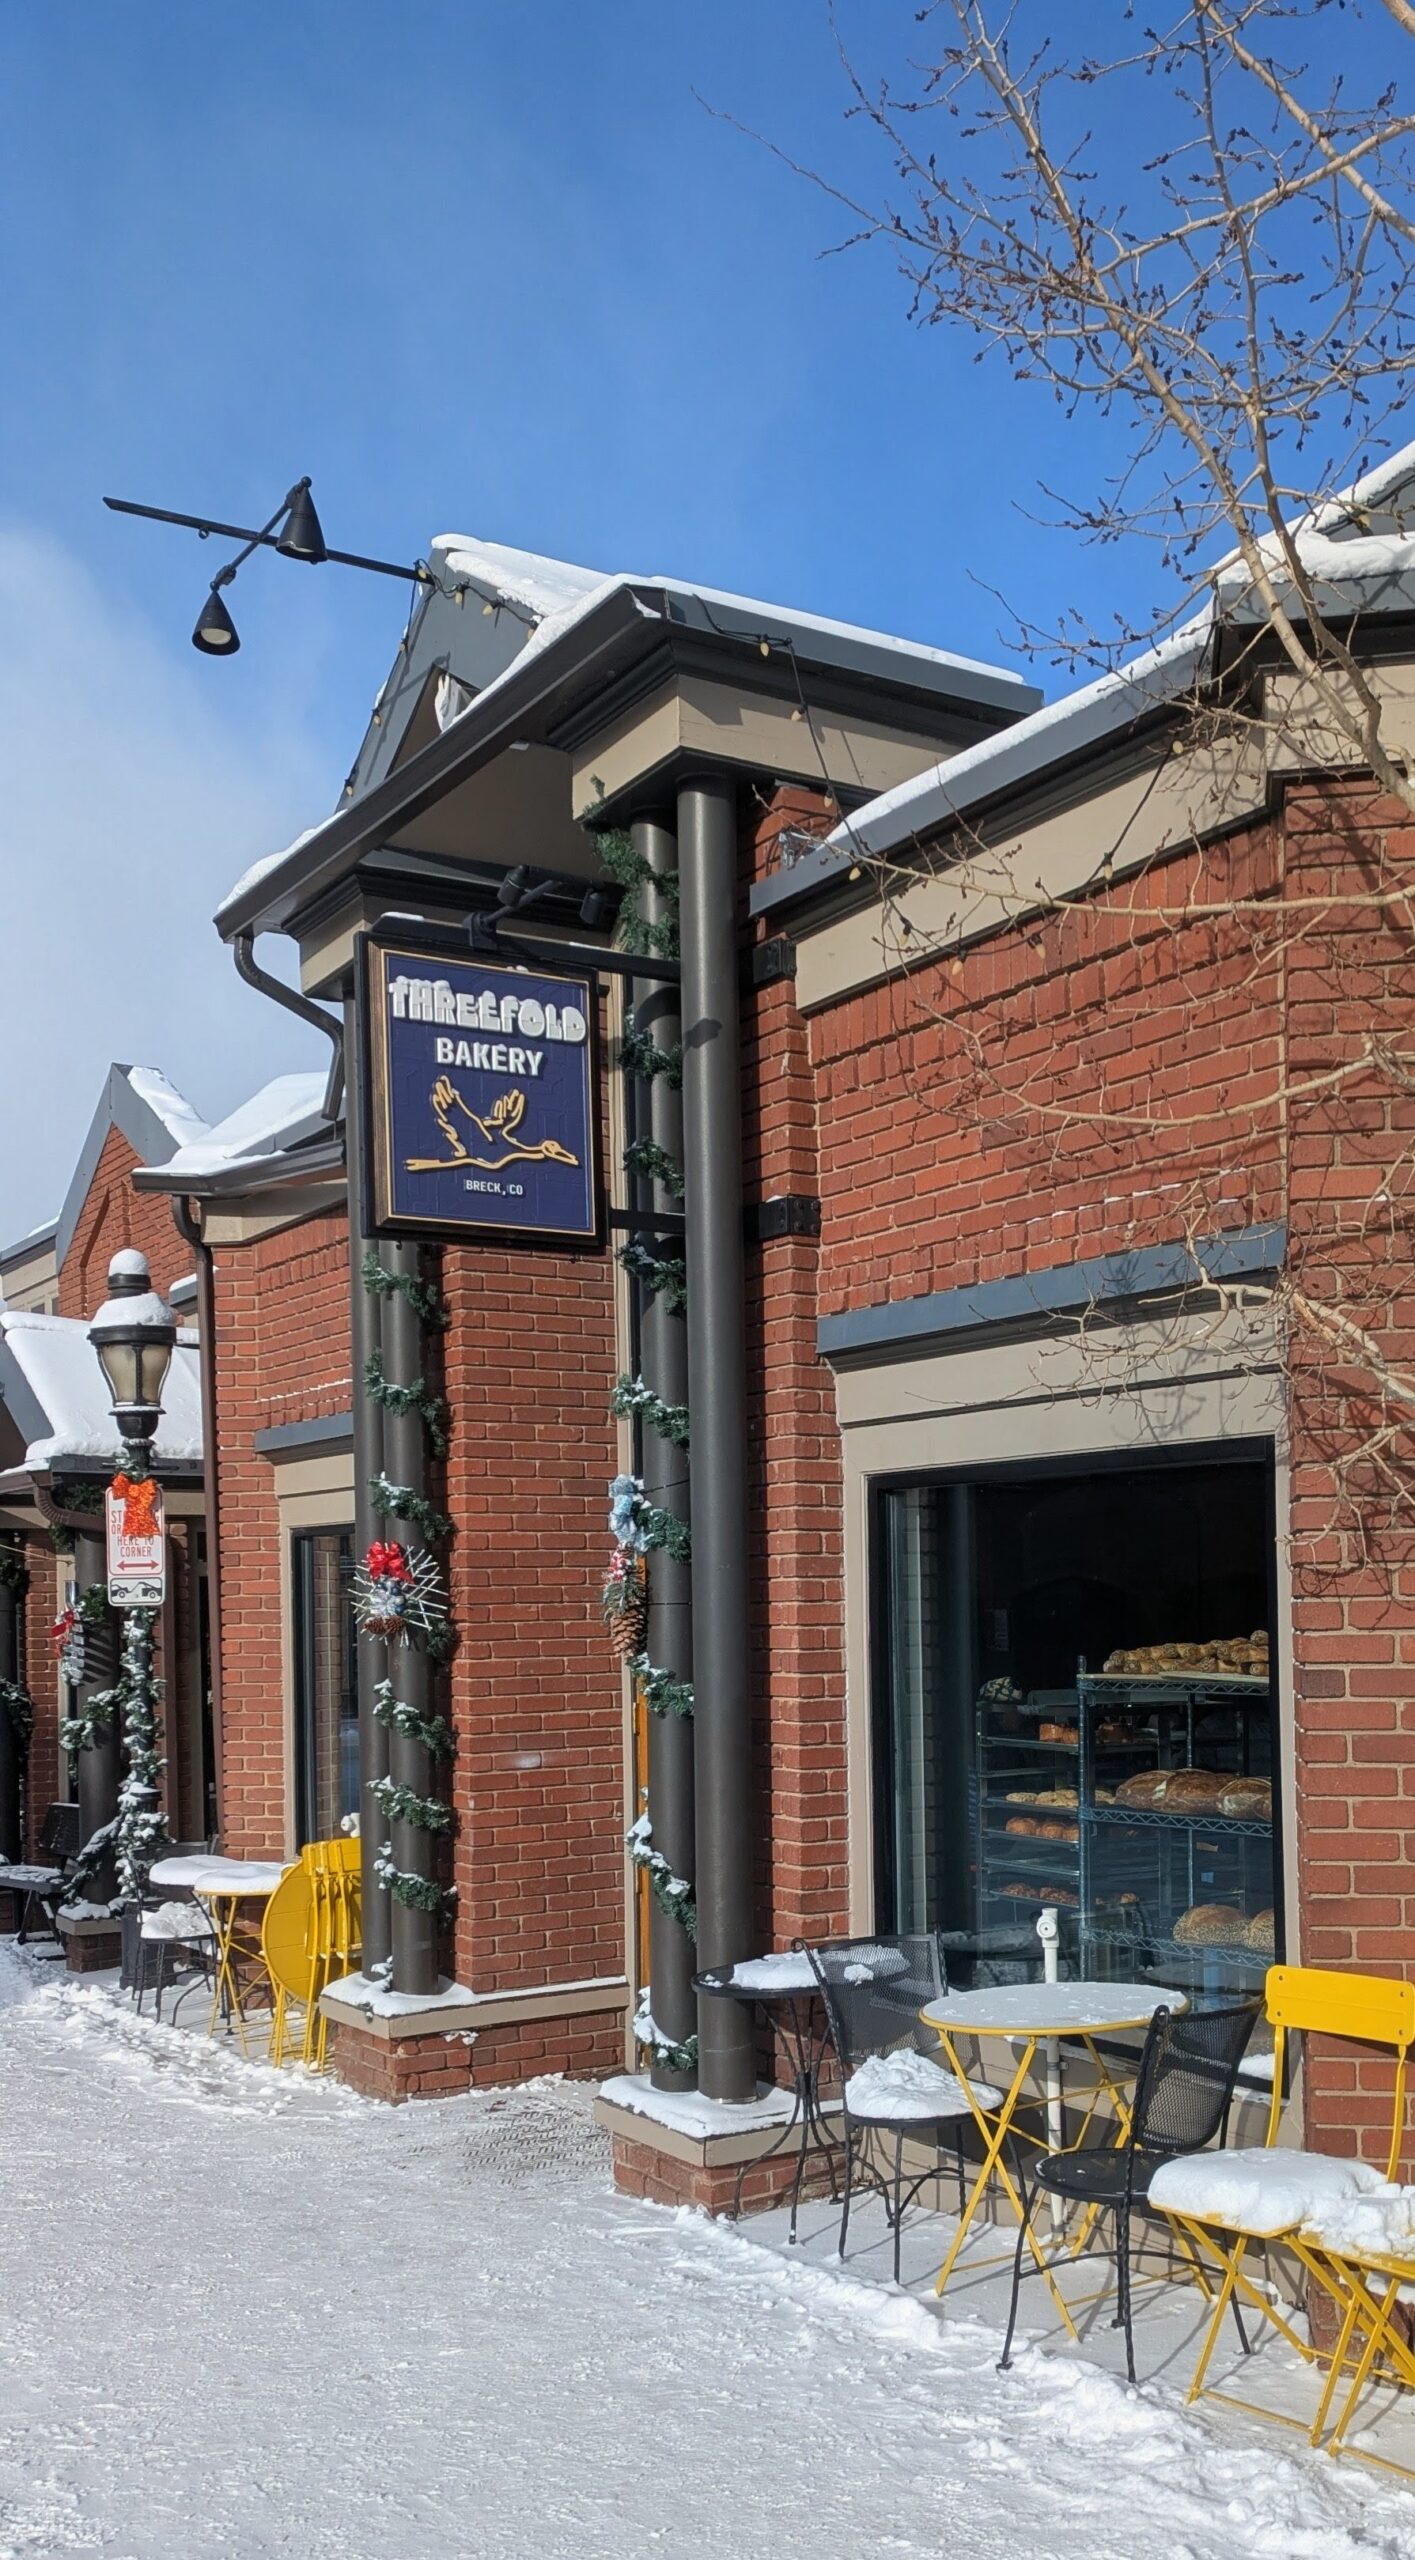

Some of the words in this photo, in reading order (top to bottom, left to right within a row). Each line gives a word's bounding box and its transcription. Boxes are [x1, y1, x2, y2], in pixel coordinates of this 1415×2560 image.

[389, 976, 587, 1042] THREEFOLD
[436, 1037, 544, 1076] BAKERY
[466, 1179, 506, 1196] BRECK,
[509, 1184, 524, 1196] CO
[117, 1534, 139, 1546] HERE
[144, 1535, 154, 1546] TO
[120, 1546, 152, 1558] CORNER
